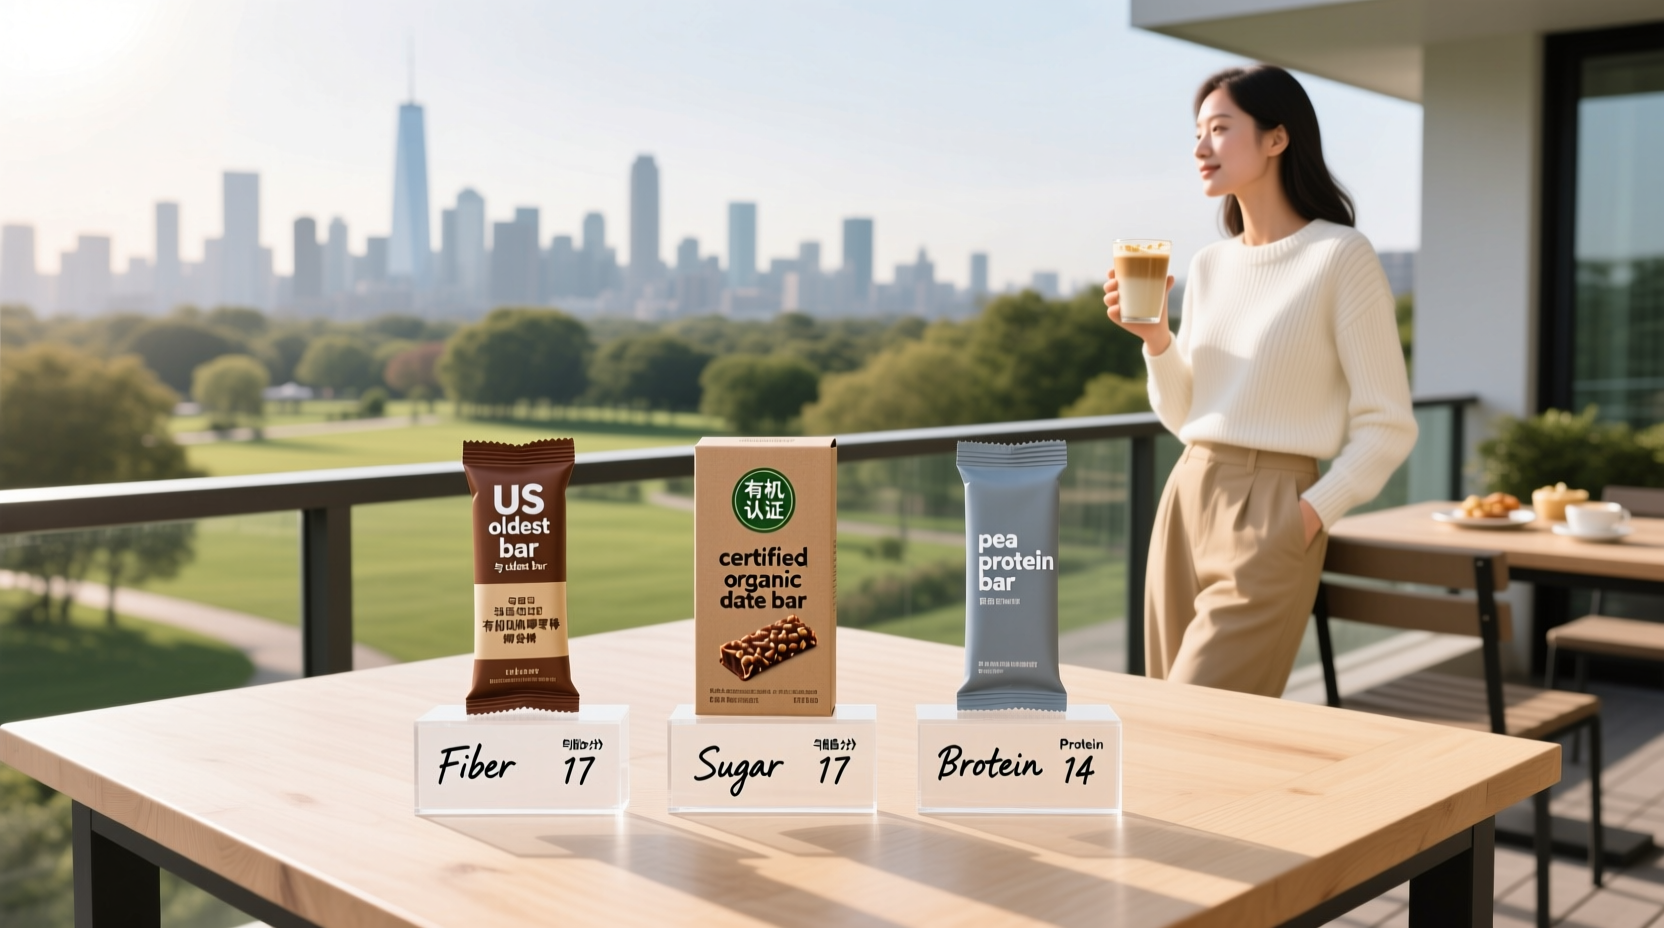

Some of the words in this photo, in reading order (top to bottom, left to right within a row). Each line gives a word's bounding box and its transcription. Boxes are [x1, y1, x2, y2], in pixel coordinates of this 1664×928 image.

[494, 483, 545, 515] US
[744, 478, 785, 499] 有机
[744, 500, 784, 520] 认证
[488, 515, 551, 535] oldest
[499, 536, 539, 558] bar
[978, 533, 1018, 553] pea
[719, 546, 808, 567] certified
[978, 549, 1054, 575] protein
[724, 569, 802, 593] organic
[978, 574, 1016, 592] bar
[720, 590, 767, 609] date
[771, 590, 808, 609] bar
[1059, 738, 1104, 750] Protein
[438, 742, 517, 785] Fiber
[564, 756, 596, 786] 17
[693, 745, 785, 797] Sugar
[819, 756, 851, 785] 17
[937, 744, 1044, 781] Brotein
[1064, 755, 1095, 785] 14
